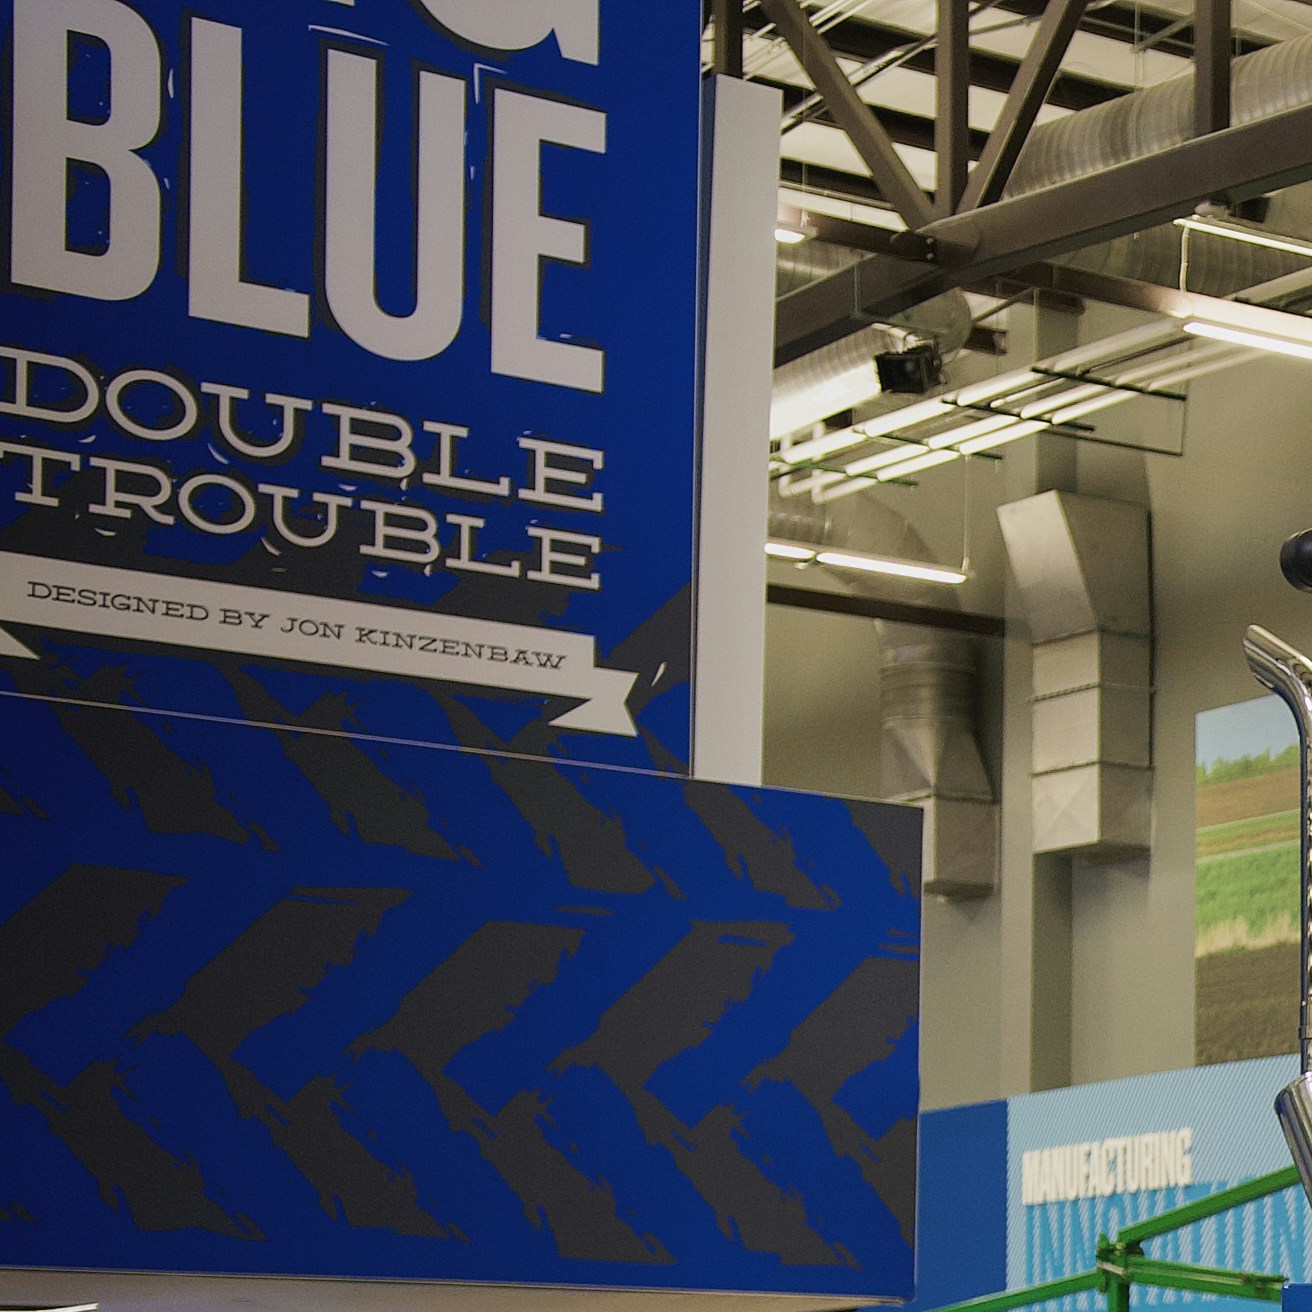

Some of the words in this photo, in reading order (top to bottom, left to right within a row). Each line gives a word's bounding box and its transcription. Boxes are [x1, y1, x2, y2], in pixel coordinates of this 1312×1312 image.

[10, 0, 607, 393] BLUE
[0, 346, 604, 512] DOUBLE
[0, 441, 600, 588] TROUBLE
[27, 581, 209, 621] DESIGNED
[219, 608, 270, 629] BY
[280, 617, 345, 640] JON
[355, 626, 568, 670] KINZENBAW
[1022, 1127, 1193, 1206] MANUFACTURING
